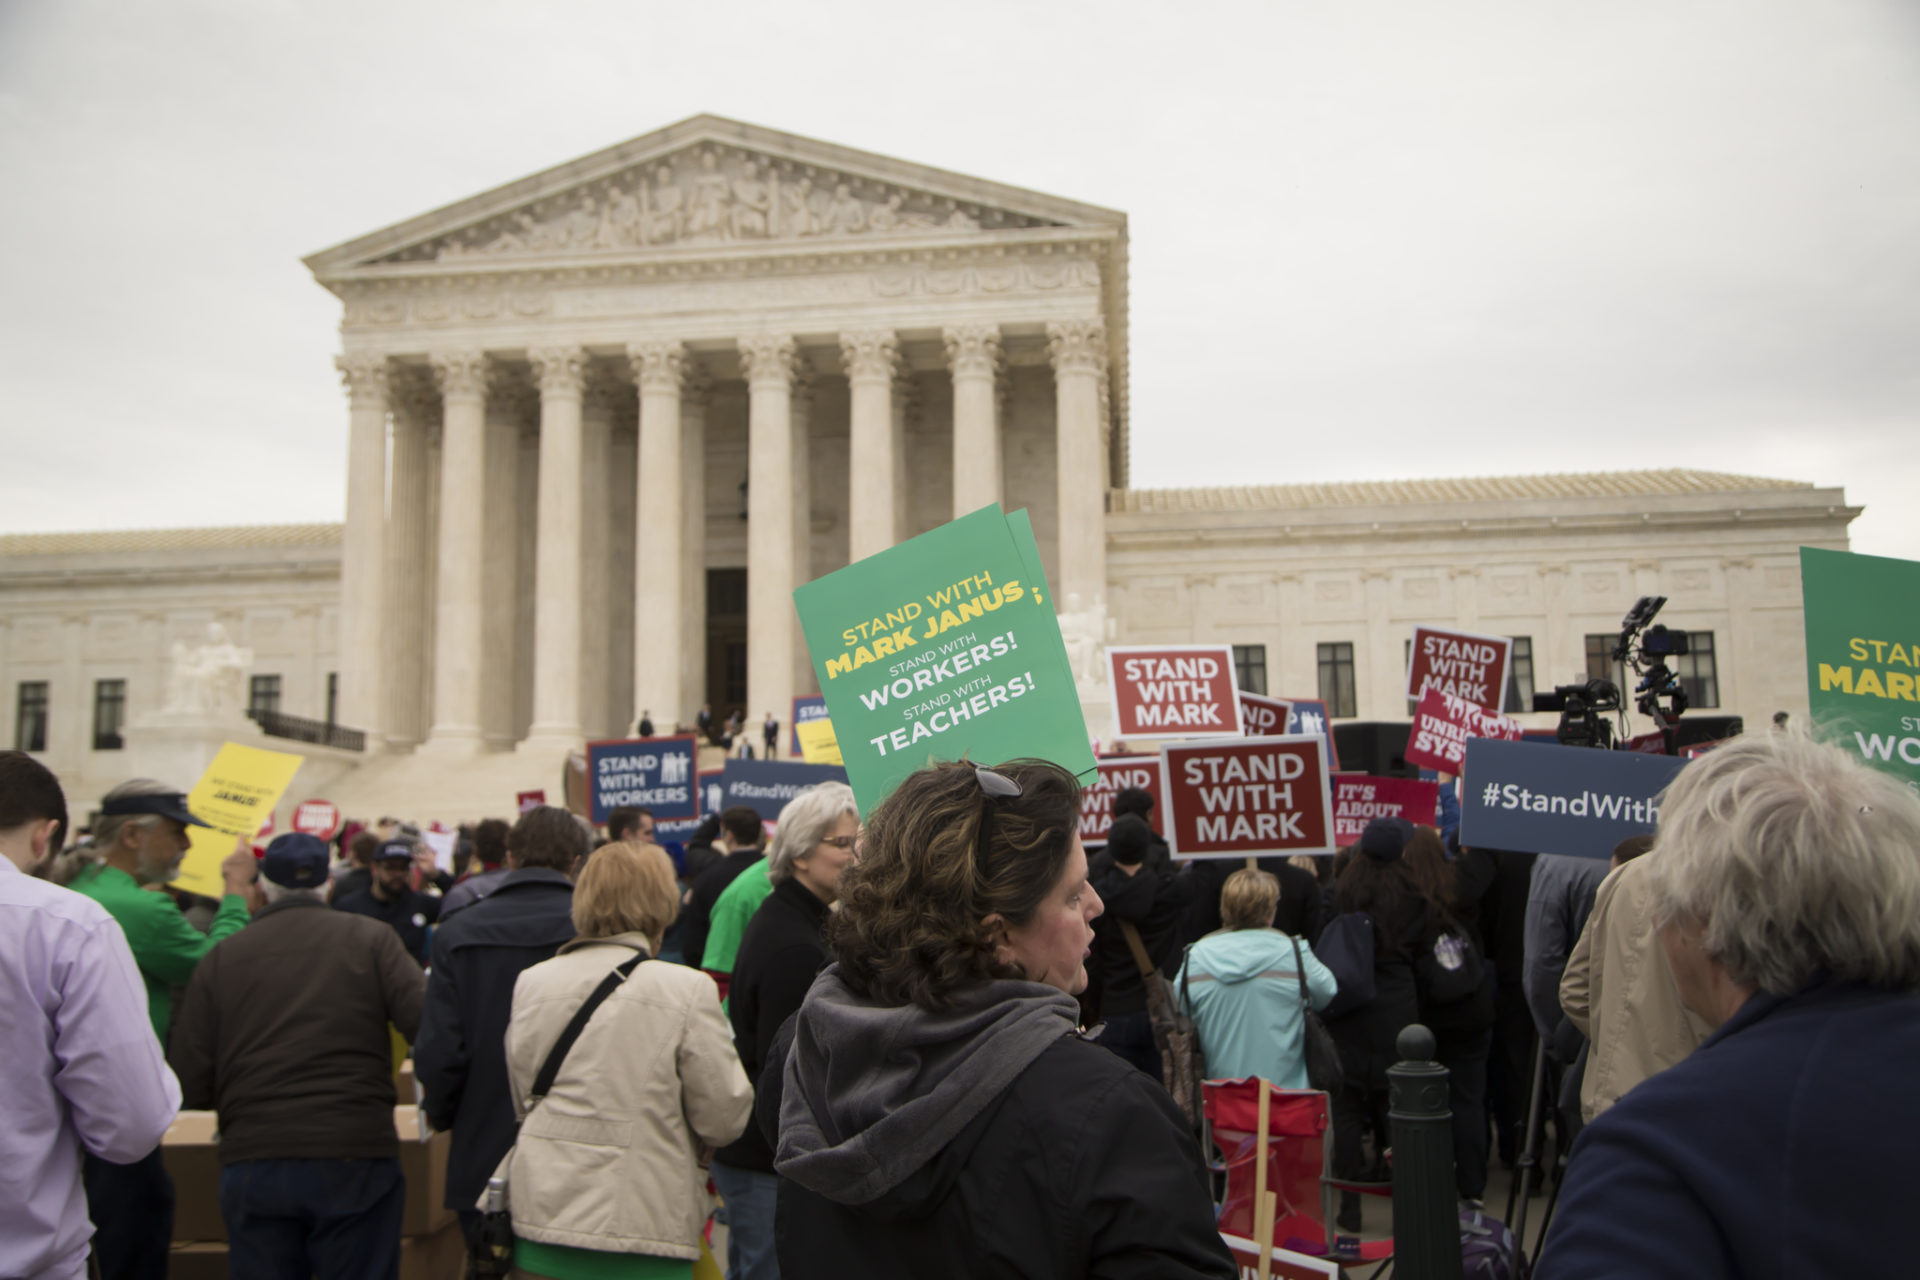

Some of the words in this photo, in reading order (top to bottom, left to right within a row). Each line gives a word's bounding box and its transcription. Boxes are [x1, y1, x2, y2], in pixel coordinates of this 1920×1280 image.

[843, 602, 923, 646] STAND
[926, 570, 993, 610] WITH
[825, 626, 918, 680] MARK
[923, 580, 1024, 639] JANUS
[888, 646, 936, 677] STAND
[938, 632, 977, 660] WITH
[1423, 636, 1497, 665] STAND
[859, 631, 1018, 712] WORKERS!
[1124, 657, 1219, 681] STAND
[1430, 655, 1486, 682] WITH
[1818, 663, 1920, 703] MAR
[903, 691, 951, 720] STAND
[953, 674, 992, 700] WITH
[1137, 681, 1212, 704] WITH
[1424, 674, 1488, 704] MARK
[870, 671, 1035, 757] TEACHERS!
[1135, 703, 1223, 728] MARK
[1414, 731, 1466, 763] SYS
[599, 755, 658, 774] STAND
[1184, 753, 1305, 785] STAND
[599, 772, 646, 791] WITH
[599, 786, 688, 808] WORKERS
[1338, 783, 1377, 801] IT'S
[1198, 783, 1294, 814] WITH
[1336, 800, 1403, 818] ABOUT
[1482, 782, 1661, 825] #StandWith
[1196, 811, 1306, 843] MARK
